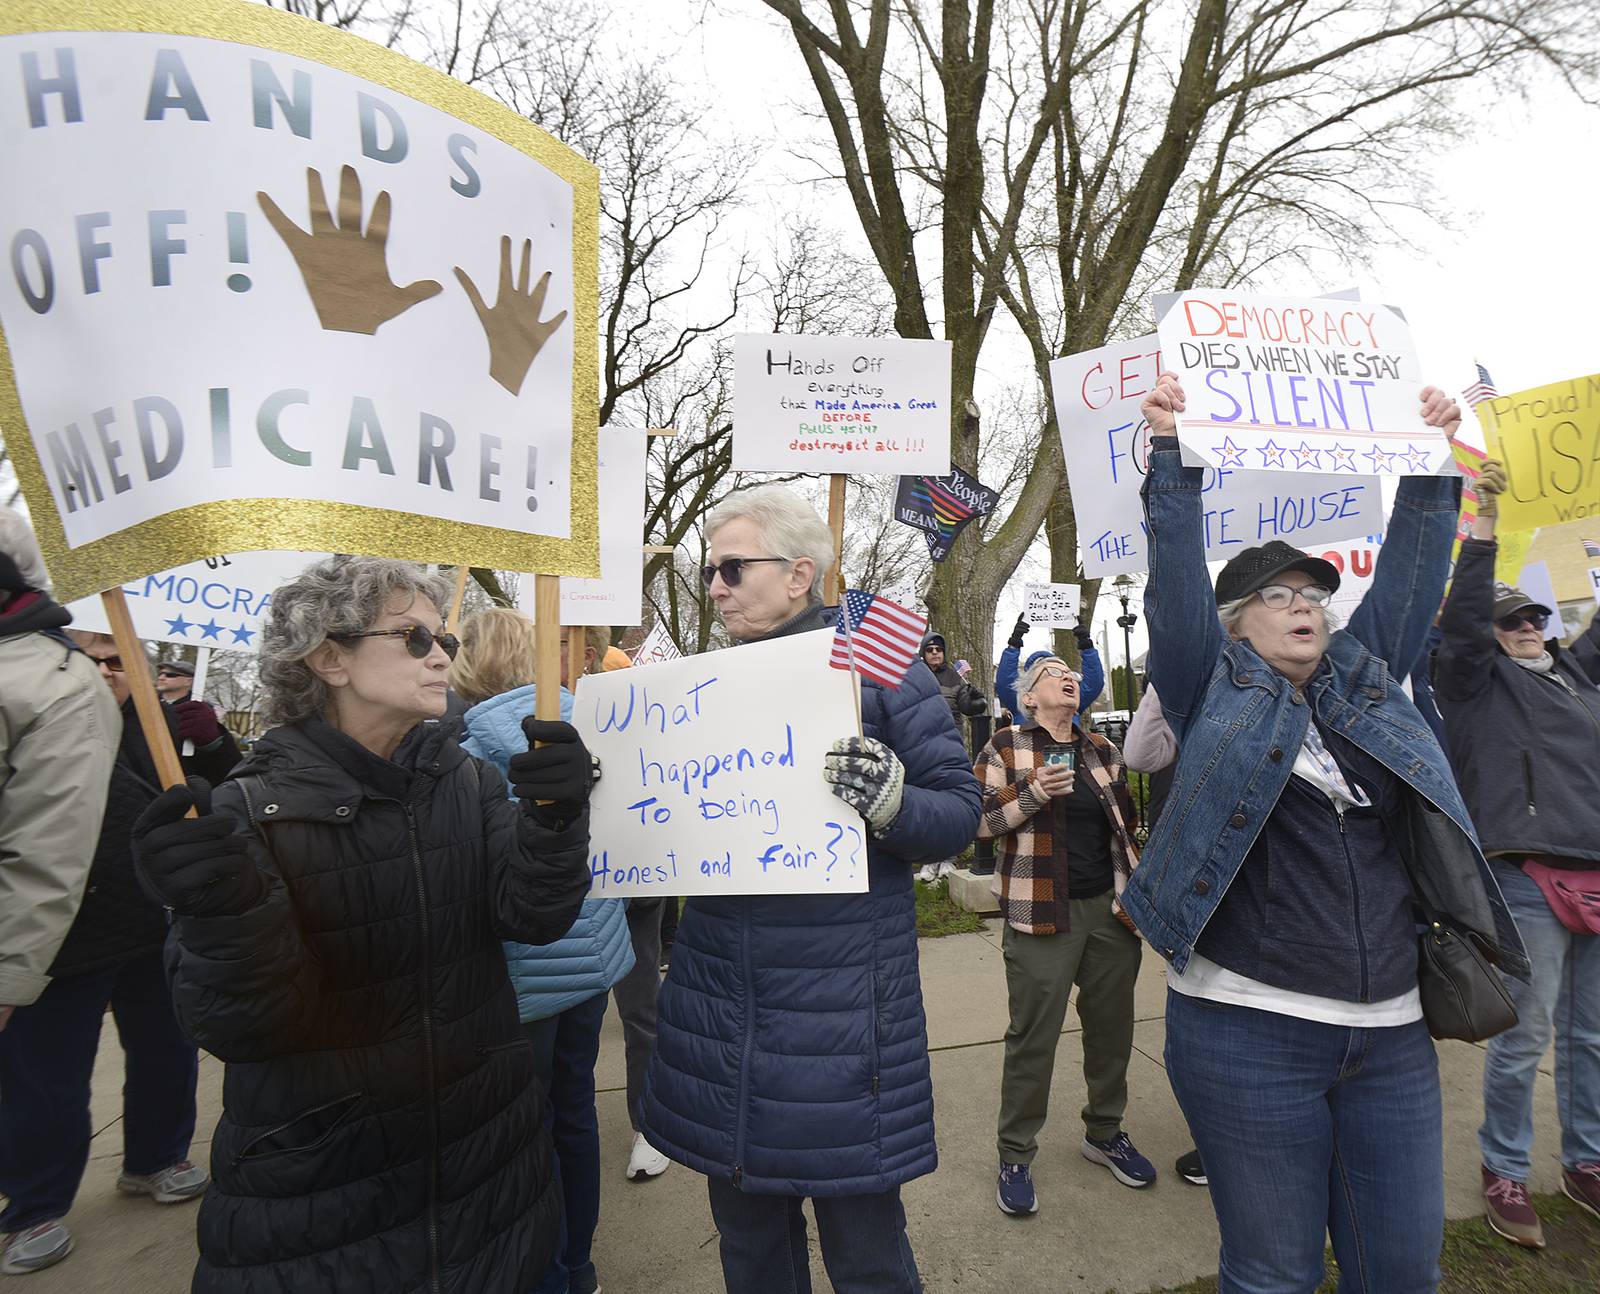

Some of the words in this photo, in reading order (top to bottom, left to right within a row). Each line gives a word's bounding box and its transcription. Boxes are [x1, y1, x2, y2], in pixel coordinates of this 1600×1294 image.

[20, 47, 482, 199] HANDS
[11, 210, 253, 314] OFF!
[1183, 300, 1378, 348] DEMOCRACY
[766, 349, 835, 375] Hands
[852, 356, 886, 374] Off
[1180, 342, 1240, 369] DIES
[1246, 346, 1312, 374] WHEN
[1315, 349, 1349, 376] WE
[1354, 352, 1401, 379] STAY
[780, 397, 807, 410] that
[815, 399, 846, 410] Made
[852, 400, 901, 410] America
[908, 398, 938, 410] Great
[807, 381, 884, 398] everything
[1206, 368, 1376, 432] SILENT
[1490, 379, 1579, 429] Proud
[822, 413, 872, 423] BEFORE
[45, 387, 539, 514] MEDICARE!
[875, 440, 899, 451] all
[950, 470, 991, 514] People
[1257, 486, 1366, 540] HOUSE
[1089, 530, 1138, 562] THE
[595, 678, 717, 733] What
[627, 797, 670, 825] To
[699, 791, 779, 835] being
[588, 849, 677, 891] Honest
[700, 852, 731, 877] and
